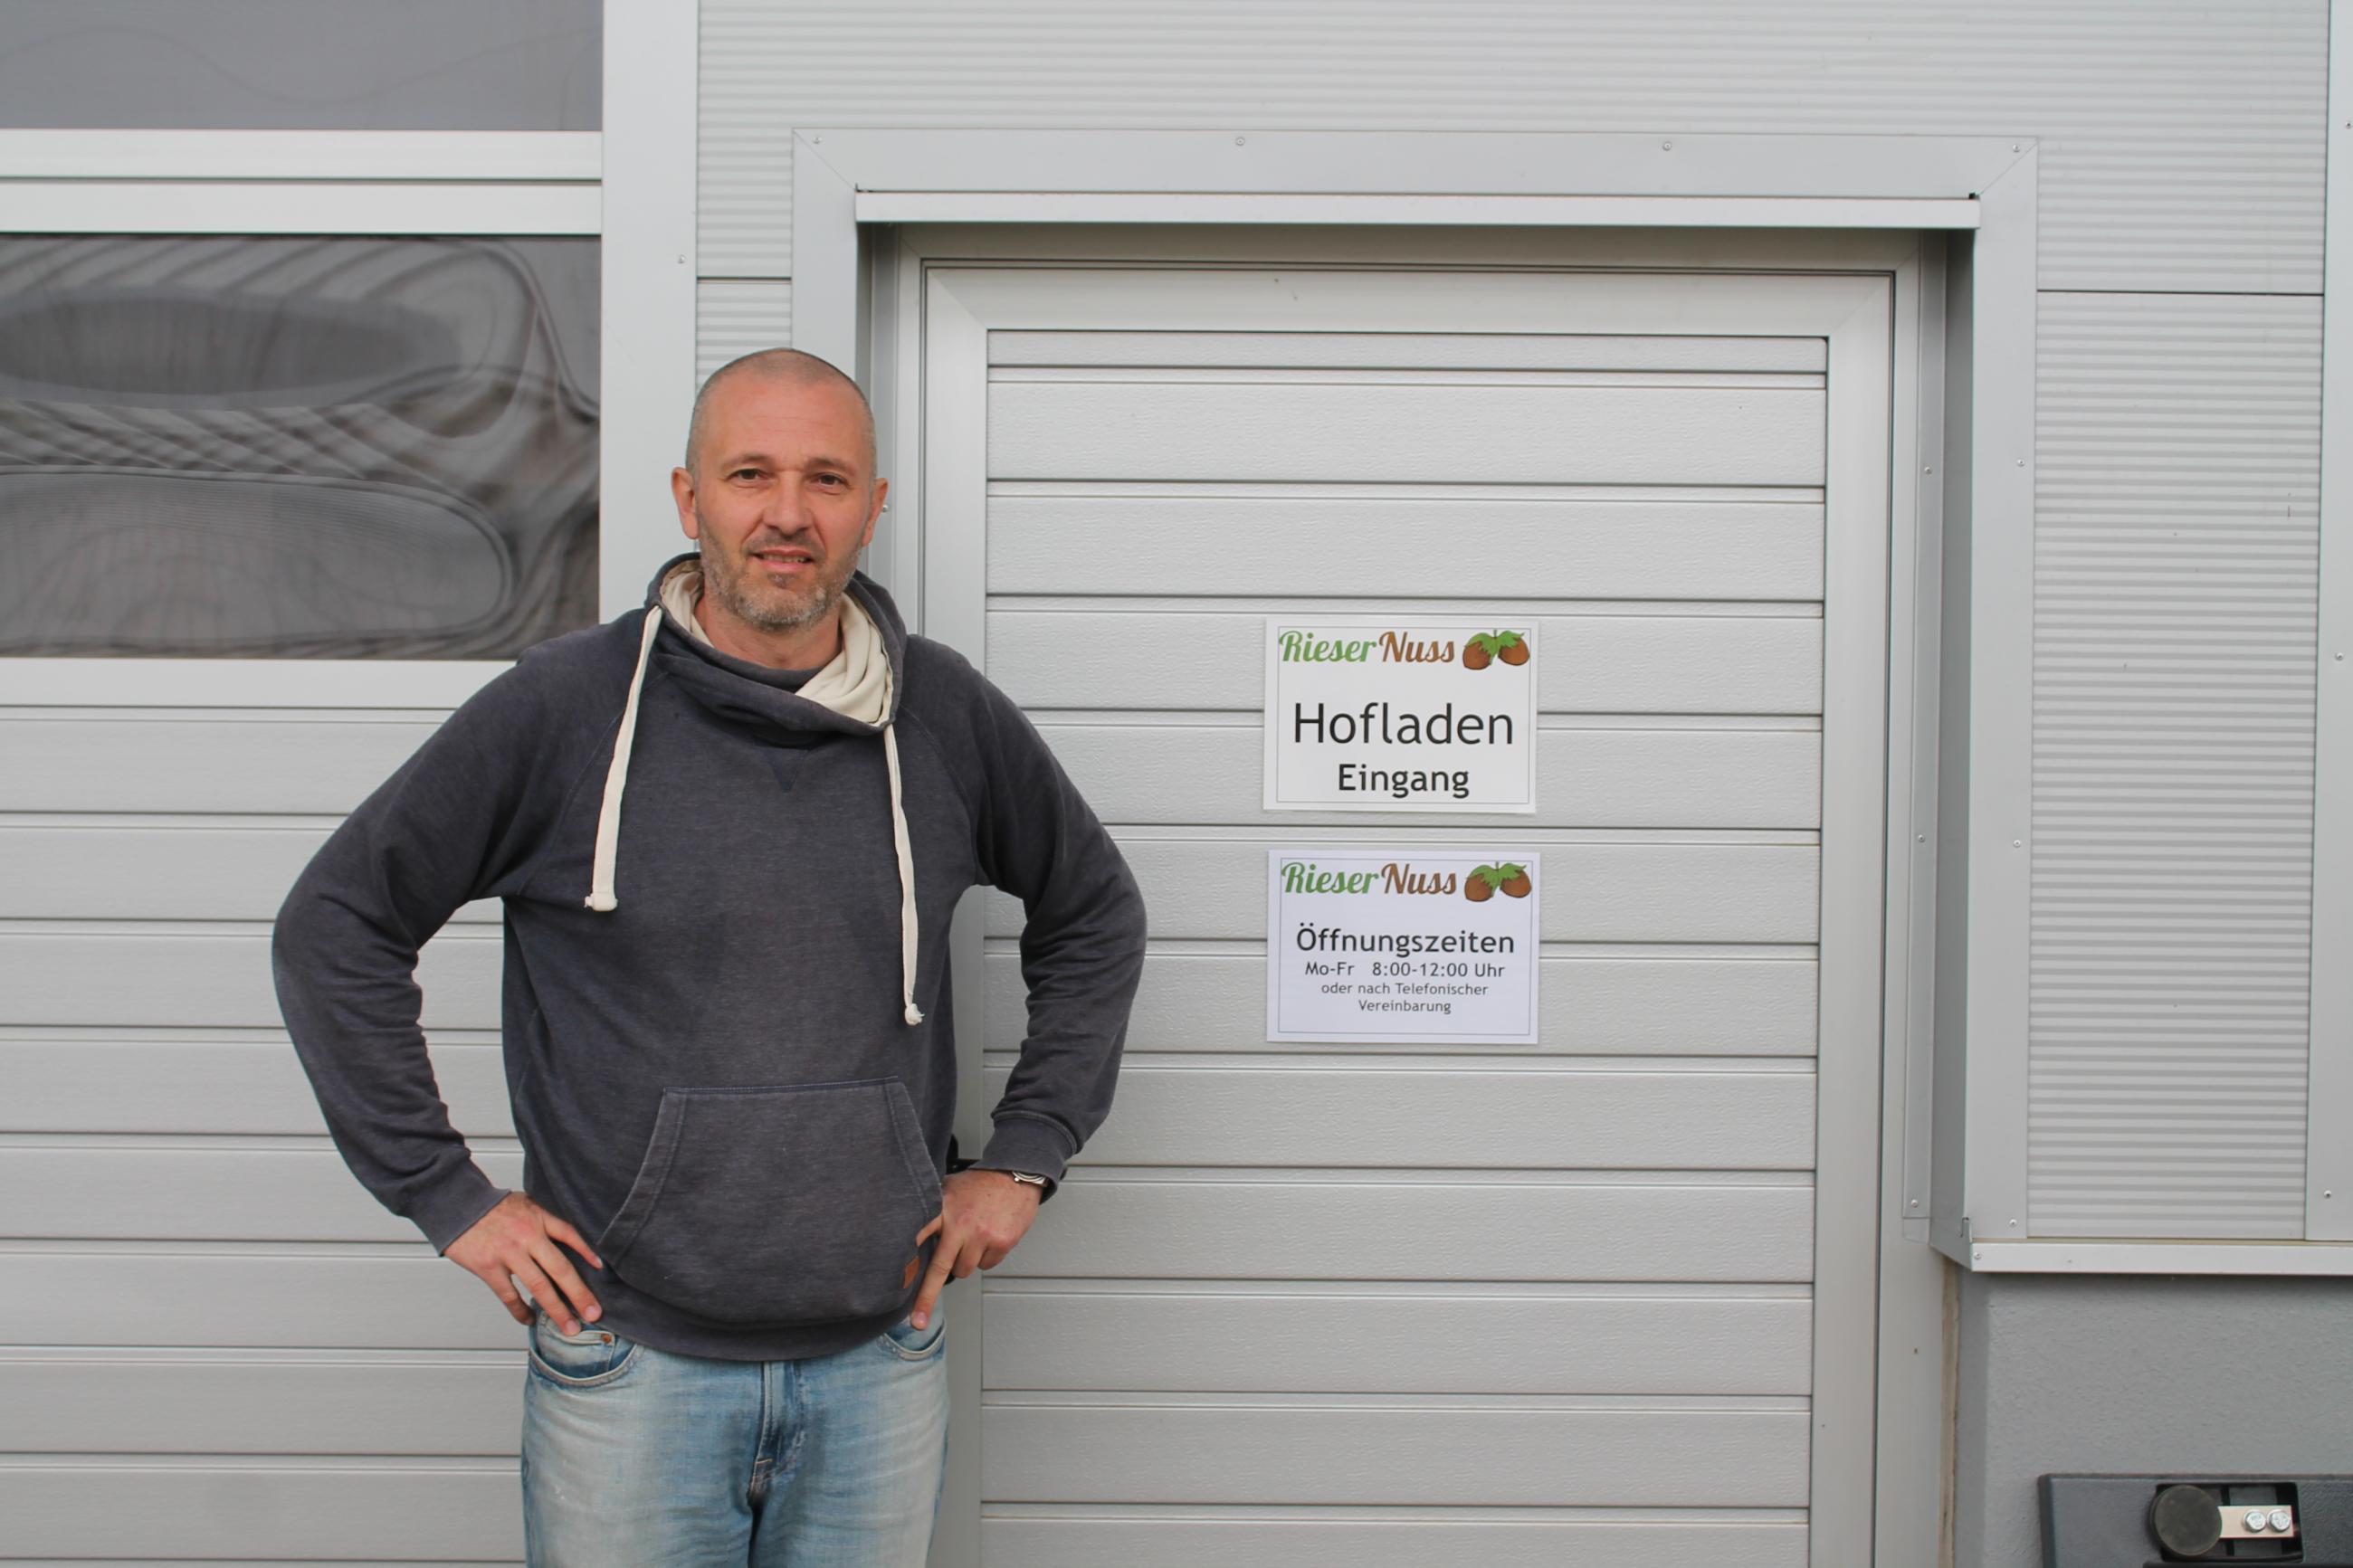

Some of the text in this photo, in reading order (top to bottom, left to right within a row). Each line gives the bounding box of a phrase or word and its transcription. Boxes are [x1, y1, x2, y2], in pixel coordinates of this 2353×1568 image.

[1295, 702, 1513, 745] Hofladen
[1338, 764, 1470, 799] Eingang
[1297, 922, 1514, 958] Öffnungszeiten
[1305, 962, 1506, 977] Mo-Fr 8:00-12:00 Uhr
[1321, 983, 1489, 996] oder nach Telefonischer
[1358, 999, 1452, 1014] Vereinbarung
